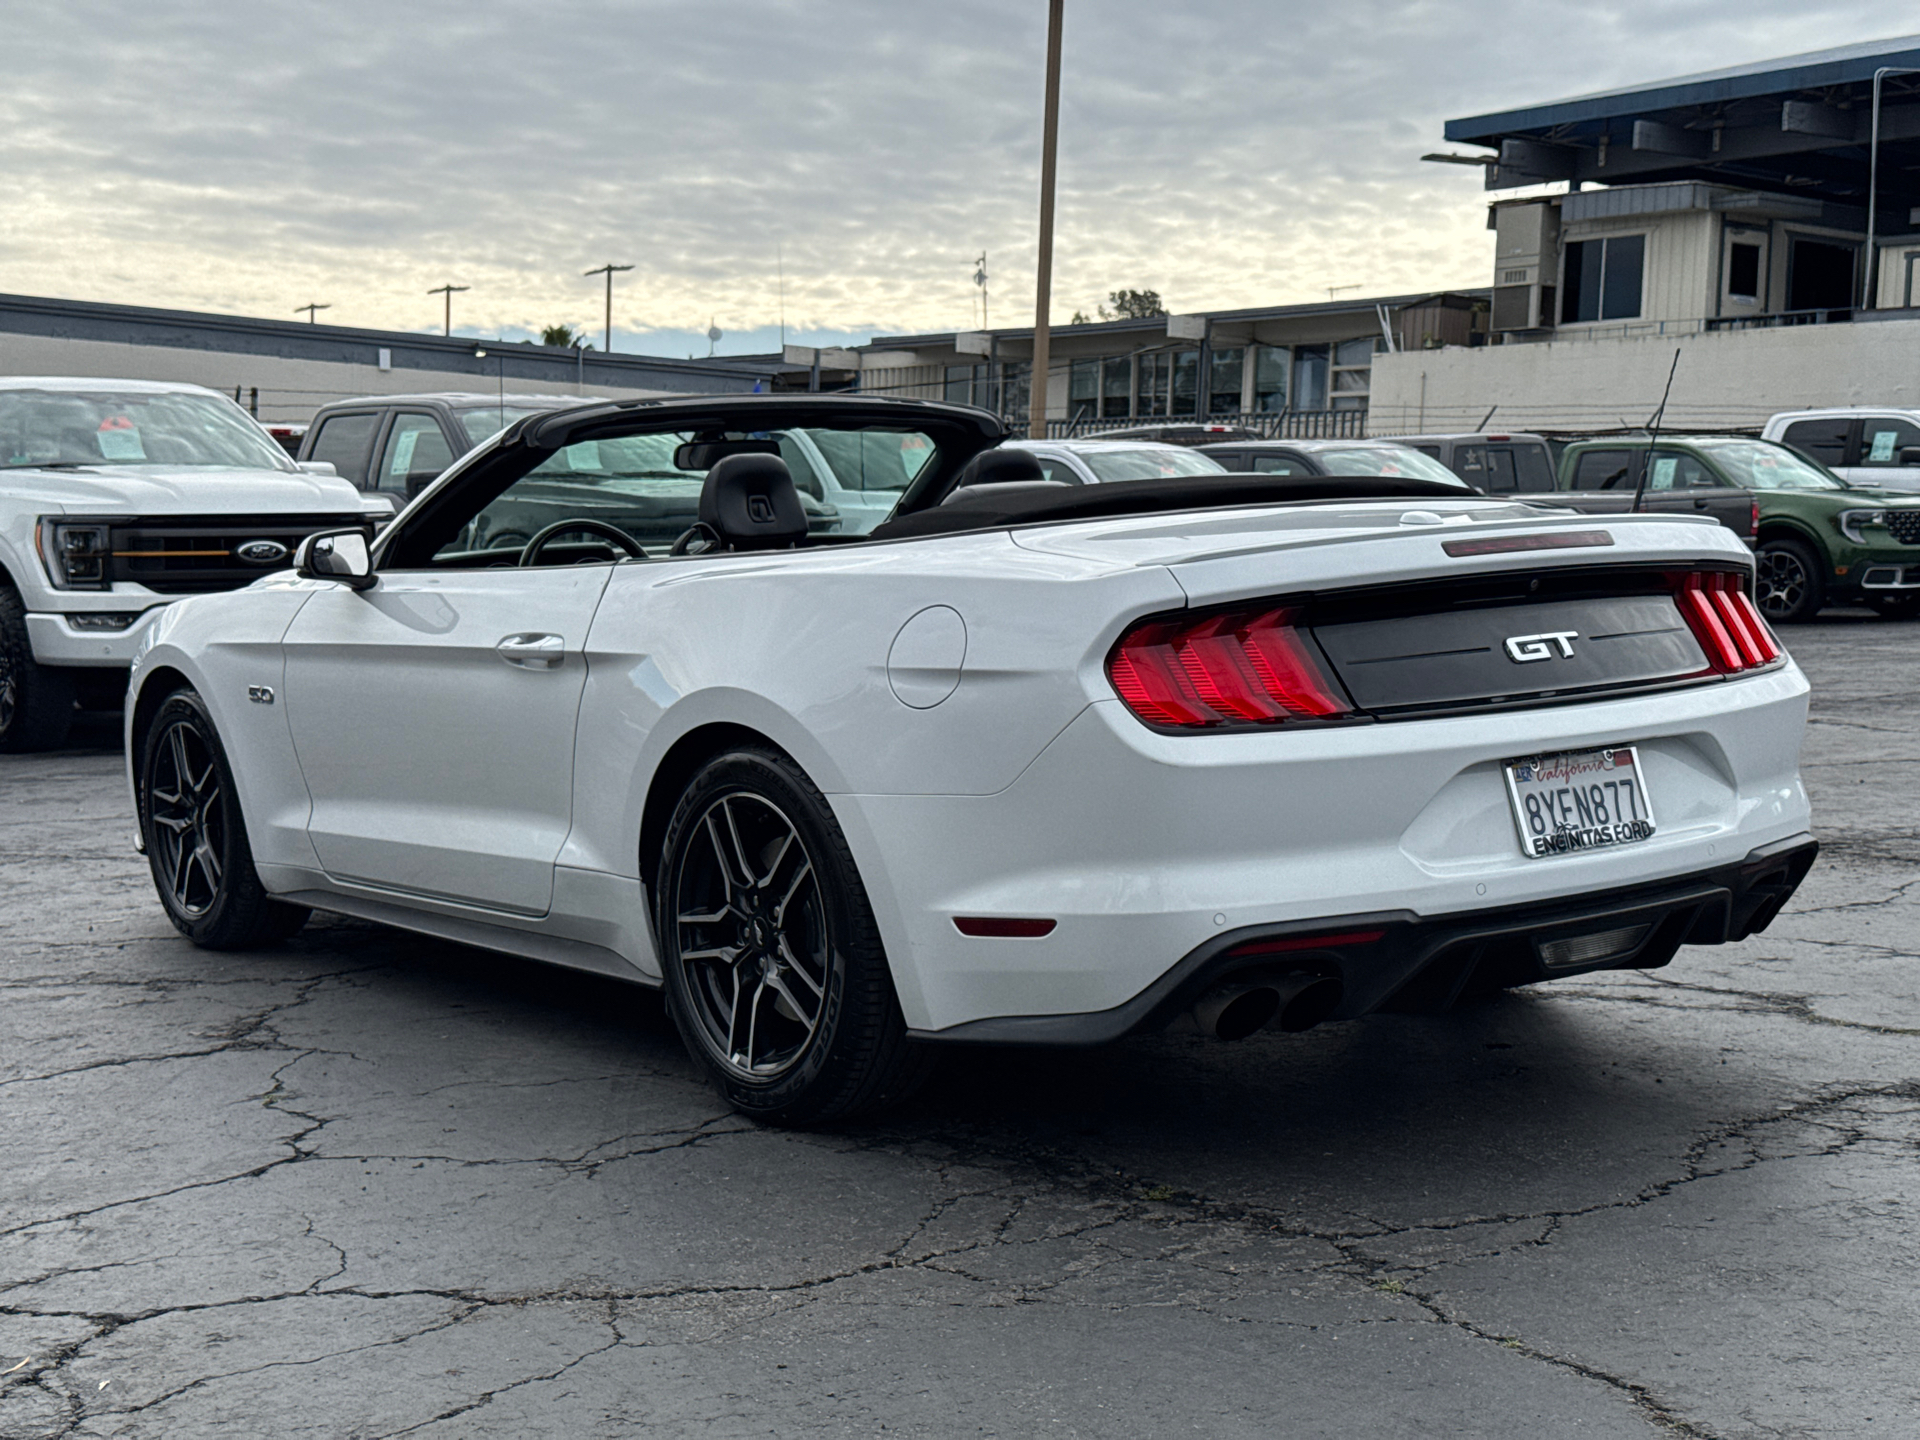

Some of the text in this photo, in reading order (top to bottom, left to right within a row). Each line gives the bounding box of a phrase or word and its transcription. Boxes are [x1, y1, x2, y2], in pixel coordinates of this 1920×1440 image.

[250, 545, 278, 558] Ford
[1503, 631, 1579, 663] GT
[1536, 757, 1614, 784] California
[1525, 779, 1637, 835] 8YEN877
[1532, 820, 1651, 855] ENCINITAS FORD
